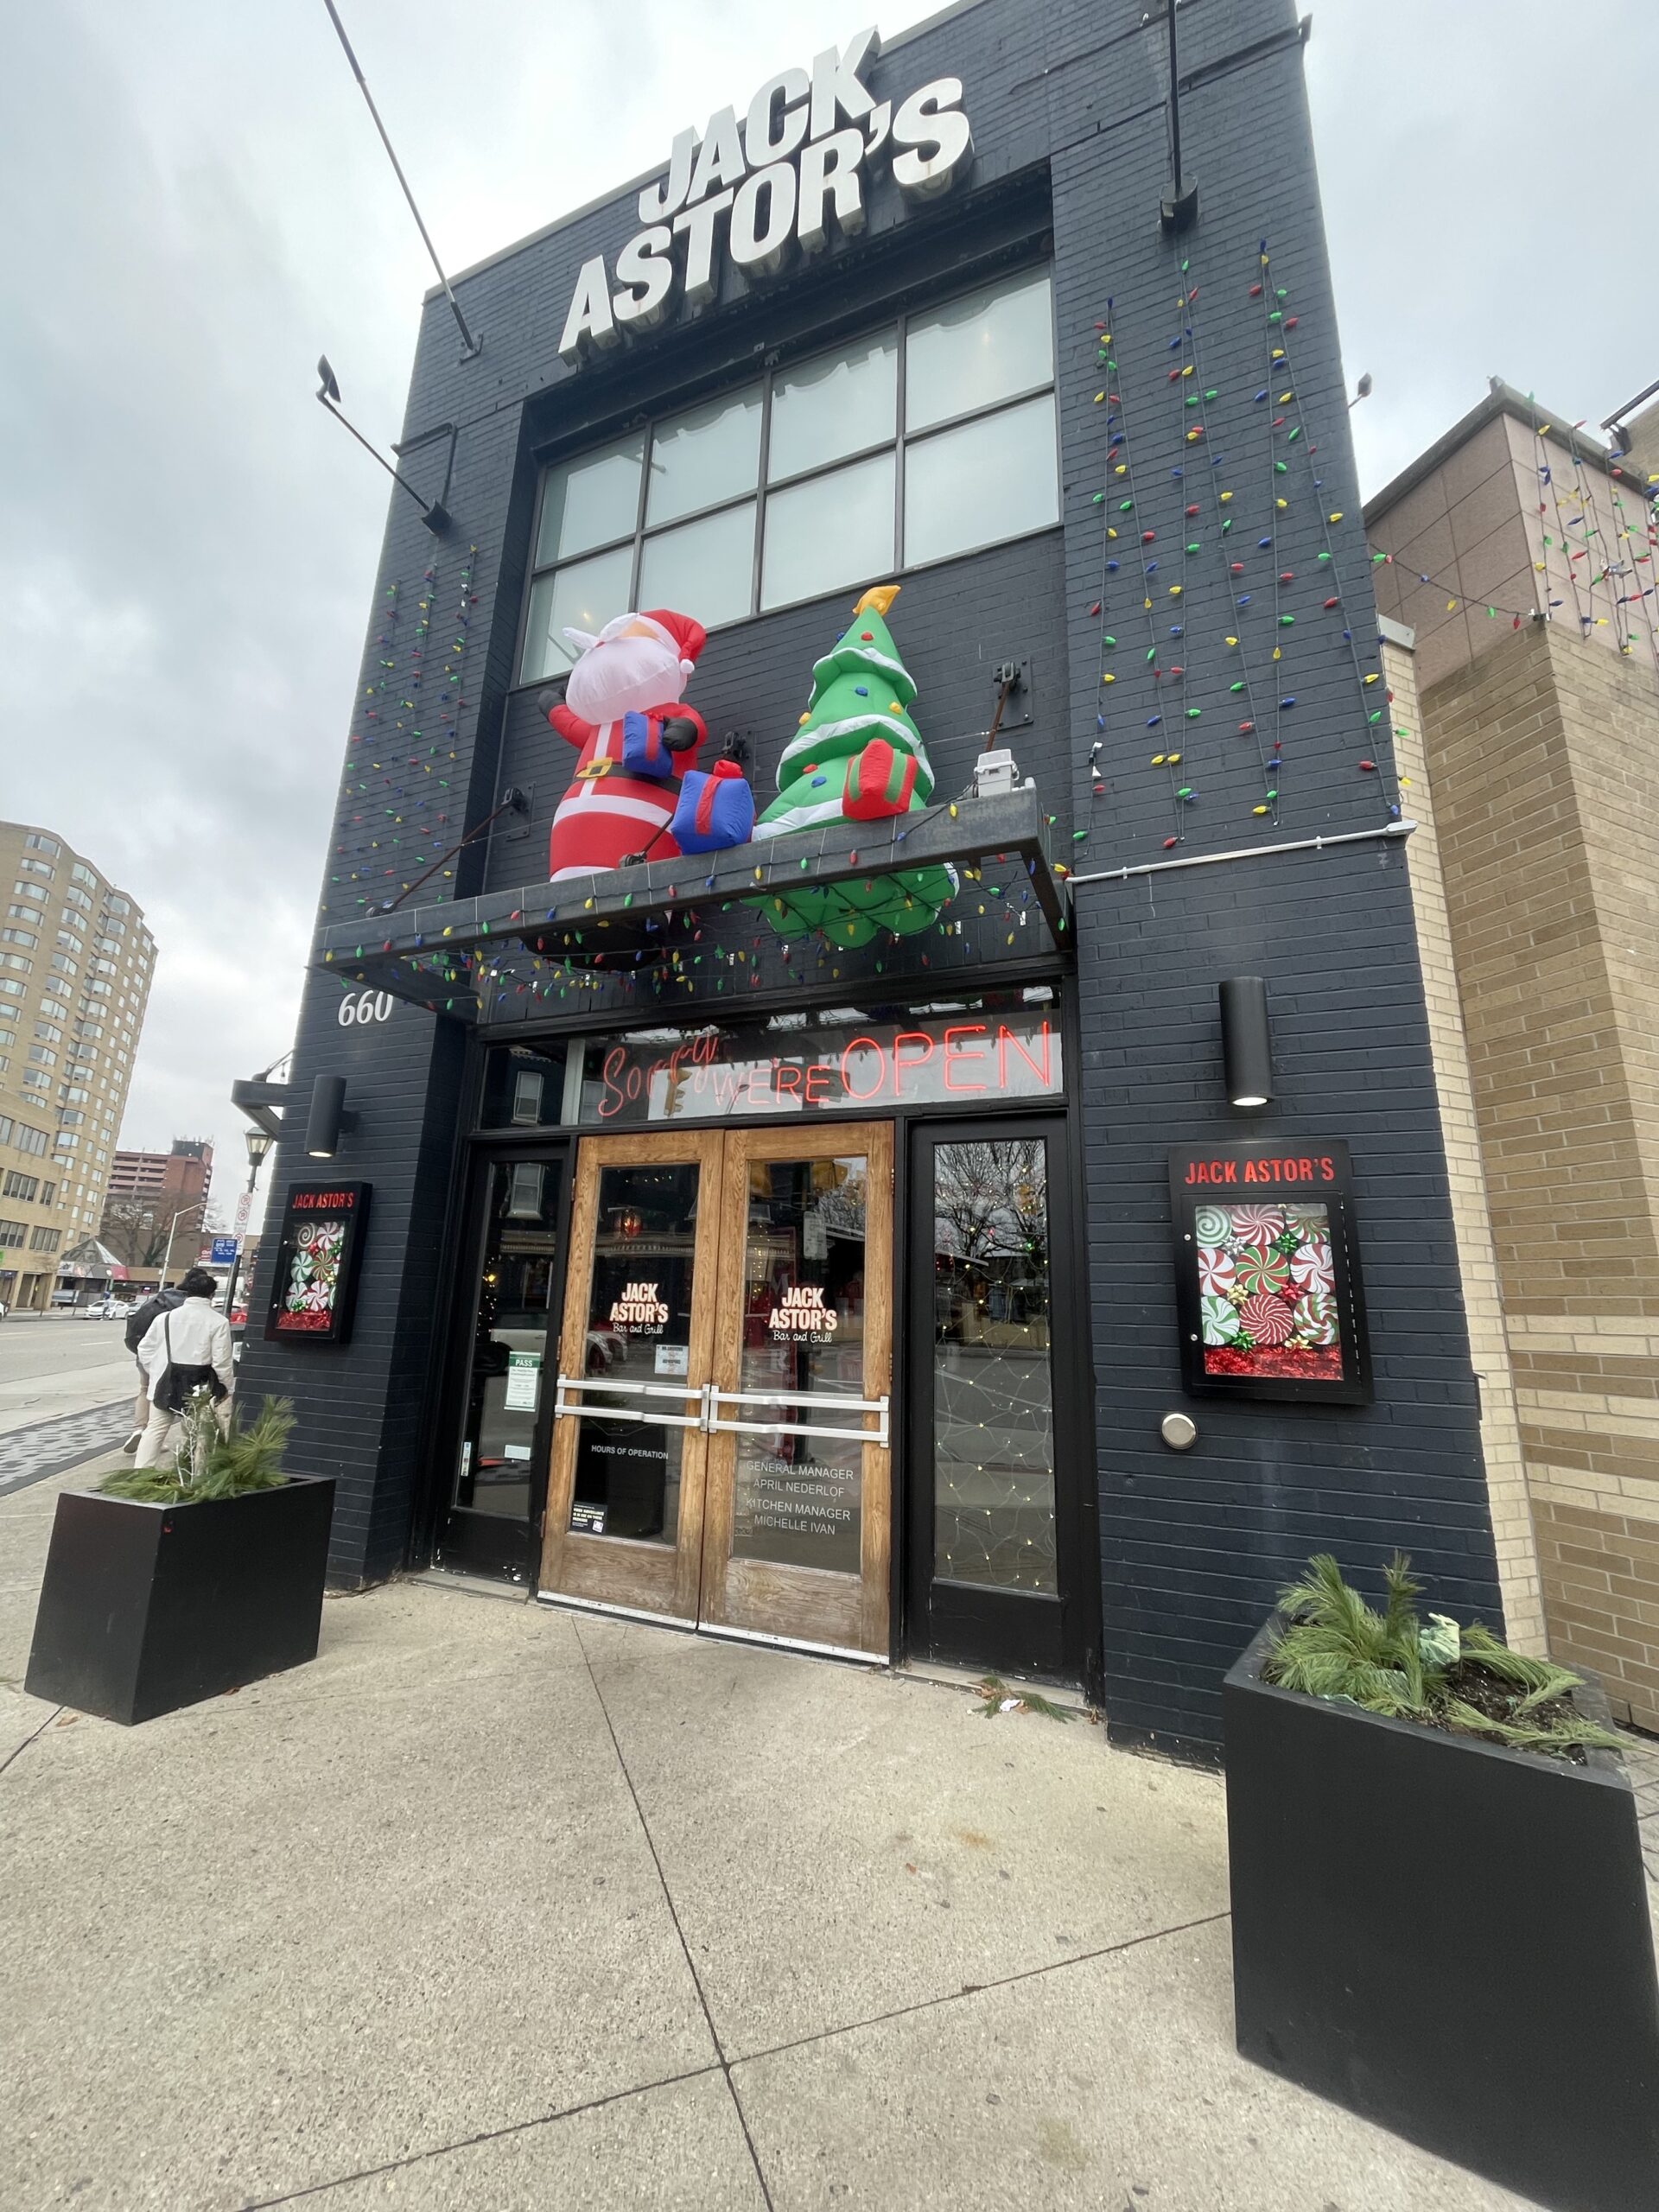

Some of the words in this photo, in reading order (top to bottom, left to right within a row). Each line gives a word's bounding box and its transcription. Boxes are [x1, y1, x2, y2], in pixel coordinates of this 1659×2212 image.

[639, 24, 880, 224] JACK
[557, 77, 971, 357] ASTOR'S
[338, 989, 394, 1027] 660
[598, 1032, 719, 1116] Sorry
[841, 1020, 1052, 1101] OPEN
[1185, 1160, 1238, 1185] JACK
[1243, 1156, 1336, 1183] ASTOR'S
[292, 1193, 315, 1209] JACK
[315, 1192, 353, 1209] ASTOR'S
[621, 1282, 658, 1302] JACK
[781, 1287, 824, 1308] JACK
[609, 1302, 669, 1324] ASTOR'S
[768, 1307, 838, 1331] ASTOR'S
[612, 1322, 628, 1333] Bar
[629, 1324, 643, 1333] and
[644, 1324, 664, 1335] Grill
[772, 1329, 791, 1341] Bar
[792, 1332, 808, 1342] and
[810, 1332, 832, 1344] Grill
[515, 1358, 533, 1367] PASS
[591, 1444, 615, 1454] HOURS
[627, 1448, 669, 1460] OPERATION
[746, 1459, 796, 1475] GENERAL
[798, 1465, 854, 1480] MANAGER
[753, 1478, 784, 1491] APRIL
[785, 1482, 845, 1497] NEDERLOF
[746, 1497, 792, 1513] KITCHEN
[795, 1503, 851, 1521] MANAGER
[754, 1514, 808, 1532] MICHELLE
[810, 1522, 836, 1535] IVAN
